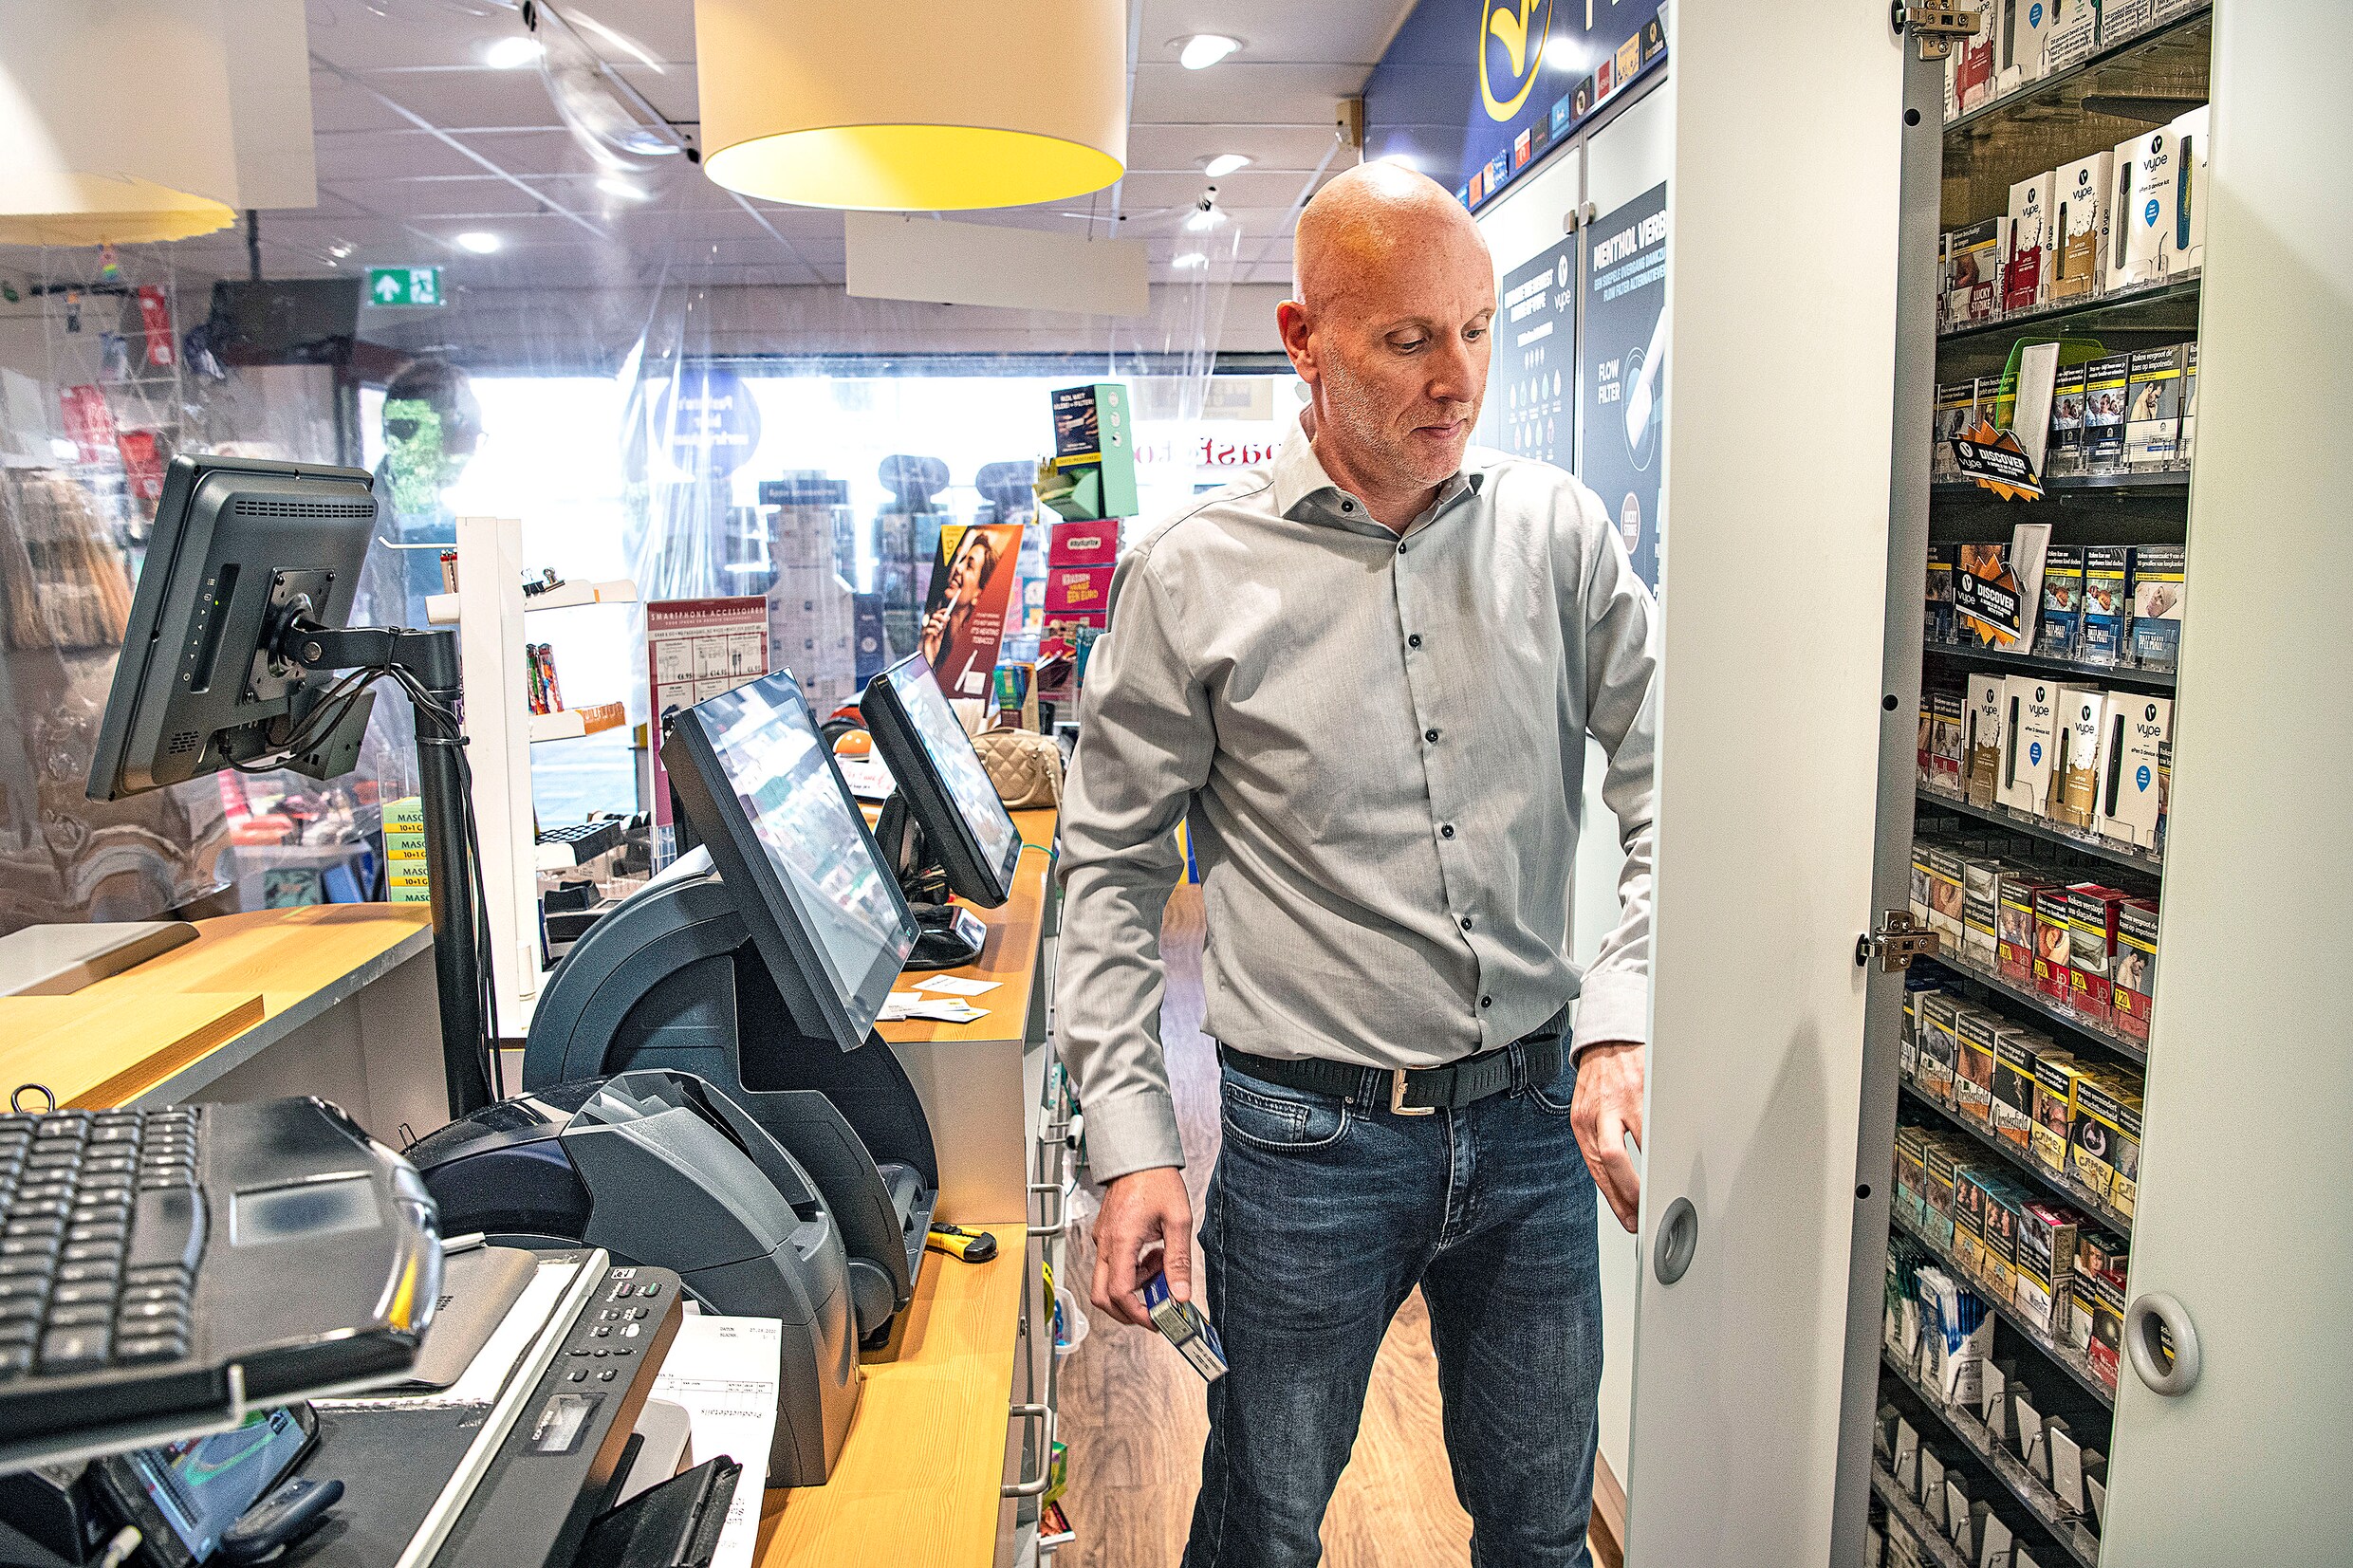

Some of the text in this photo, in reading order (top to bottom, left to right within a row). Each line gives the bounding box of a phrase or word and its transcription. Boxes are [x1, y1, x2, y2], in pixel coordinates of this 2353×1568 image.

[2144, 155, 2168, 173] vype
[2073, 186, 2093, 201] vype
[2022, 204, 2039, 218] vype
[1594, 226, 1638, 272] MENTHOL
[1554, 289, 1571, 312] vype
[1973, 286, 1992, 301] LUCKY
[2147, 351, 2165, 360] vergroot
[1599, 359, 1620, 382] FLOW
[2149, 360, 2173, 370] impotentie
[1599, 380, 1621, 405] FILTER
[1959, 457, 1982, 470] vype
[1978, 449, 2027, 470] DISCOVER
[1957, 591, 1975, 605] vype
[1977, 583, 2014, 611] DISCOVER
[651, 607, 763, 620] SMARTPHONE ACCESSOIRES
[1981, 705, 1997, 716] vype
[2029, 704, 2049, 717] vype
[2075, 722, 2094, 735] vype
[2137, 723, 2161, 738] vype
[2067, 895, 2104, 915] Roken verstopt
[2076, 909, 2103, 925] slagaderen
[2119, 919, 2128, 929] kans
[2120, 911, 2158, 931] Roken vergroot de
[2078, 1084, 2092, 1098] Roken
[1993, 1103, 2029, 1130] Chesterfield
[2034, 1130, 2063, 1153] CAMEL
[2079, 1155, 2108, 1183] CAMEL
[700, 1409, 762, 1419] Productdetails
